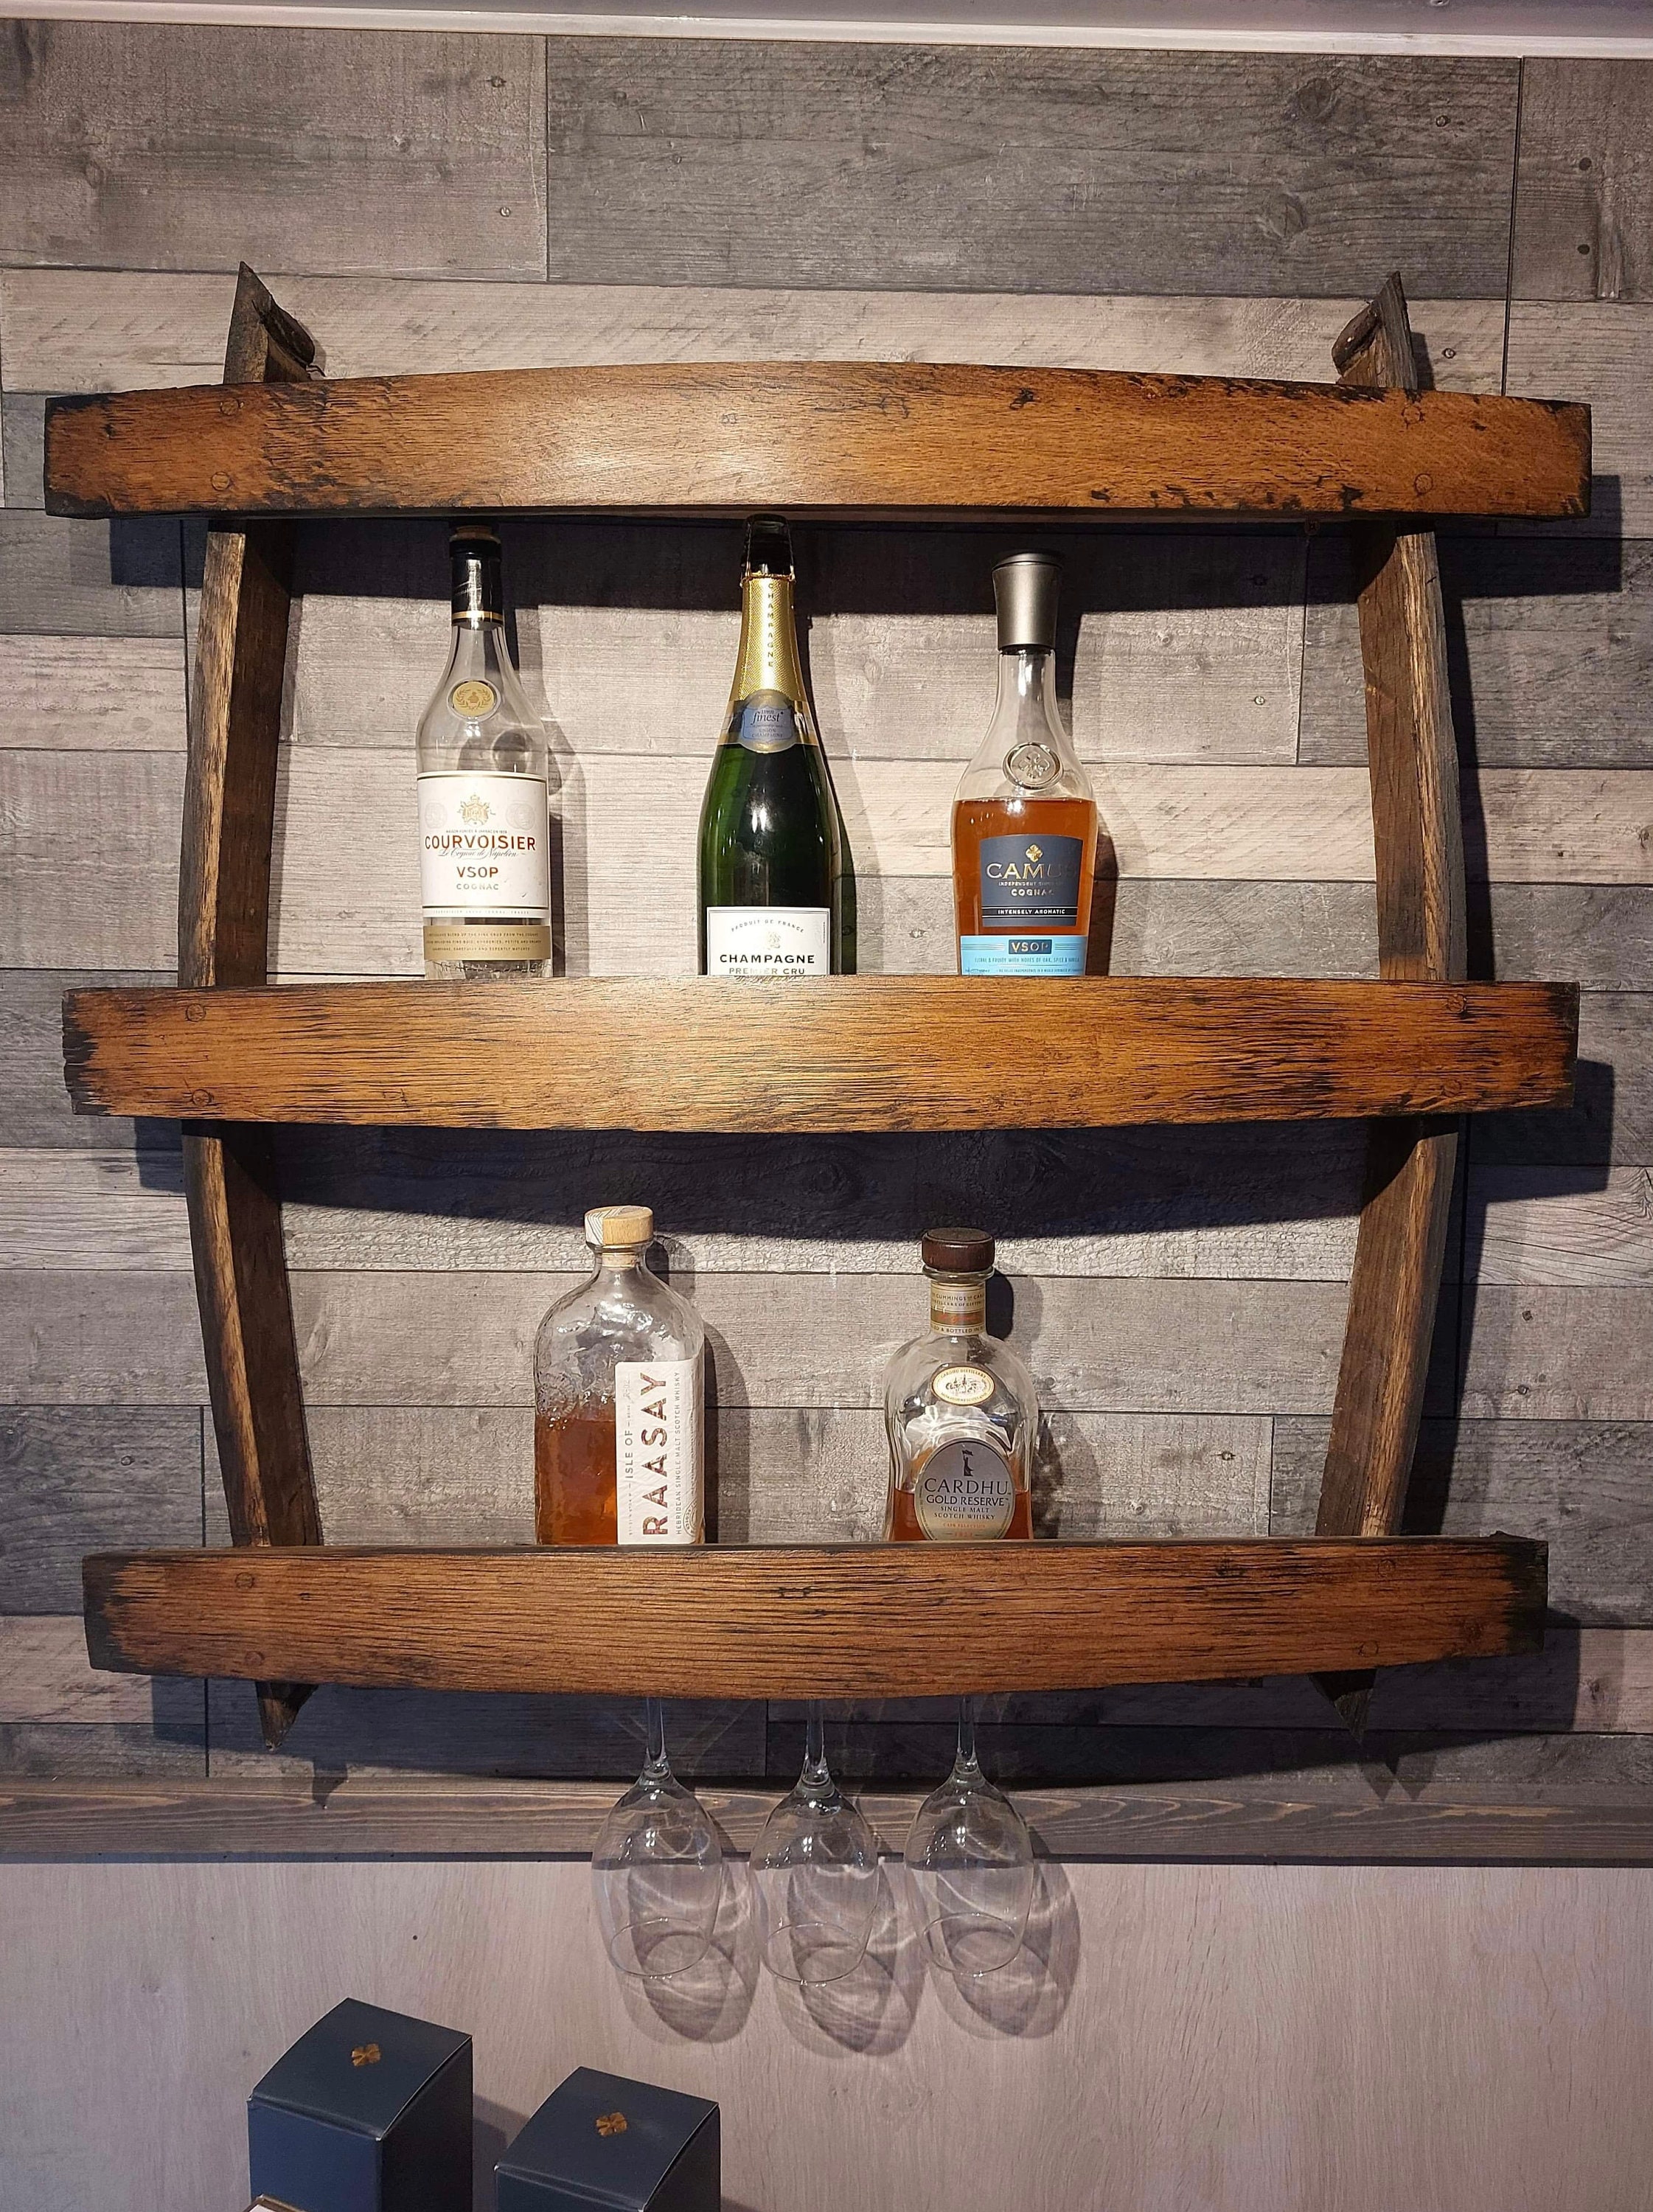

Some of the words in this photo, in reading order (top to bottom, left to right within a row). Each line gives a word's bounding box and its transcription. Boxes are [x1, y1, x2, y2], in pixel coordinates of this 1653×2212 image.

[425, 835, 536, 851] COURVOISIER
[456, 866, 499, 878] VSOP
[986, 863, 1076, 880] CAMU
[1011, 888, 1054, 897] COGNAC
[778, 920, 804, 933] FRANCE
[1011, 942, 1048, 953] VSOP
[720, 954, 815, 964] CHAMPAGNE
[936, 1293, 966, 1301] CUMMINGS
[624, 1430, 633, 1445] OF
[640, 1372, 669, 1535] RAASAY
[624, 1452, 633, 1478] ISLE
[924, 1478, 1009, 1495] CARDHU
[926, 1495, 958, 1506] GOLD
[961, 1496, 1005, 1506] RESERVE
